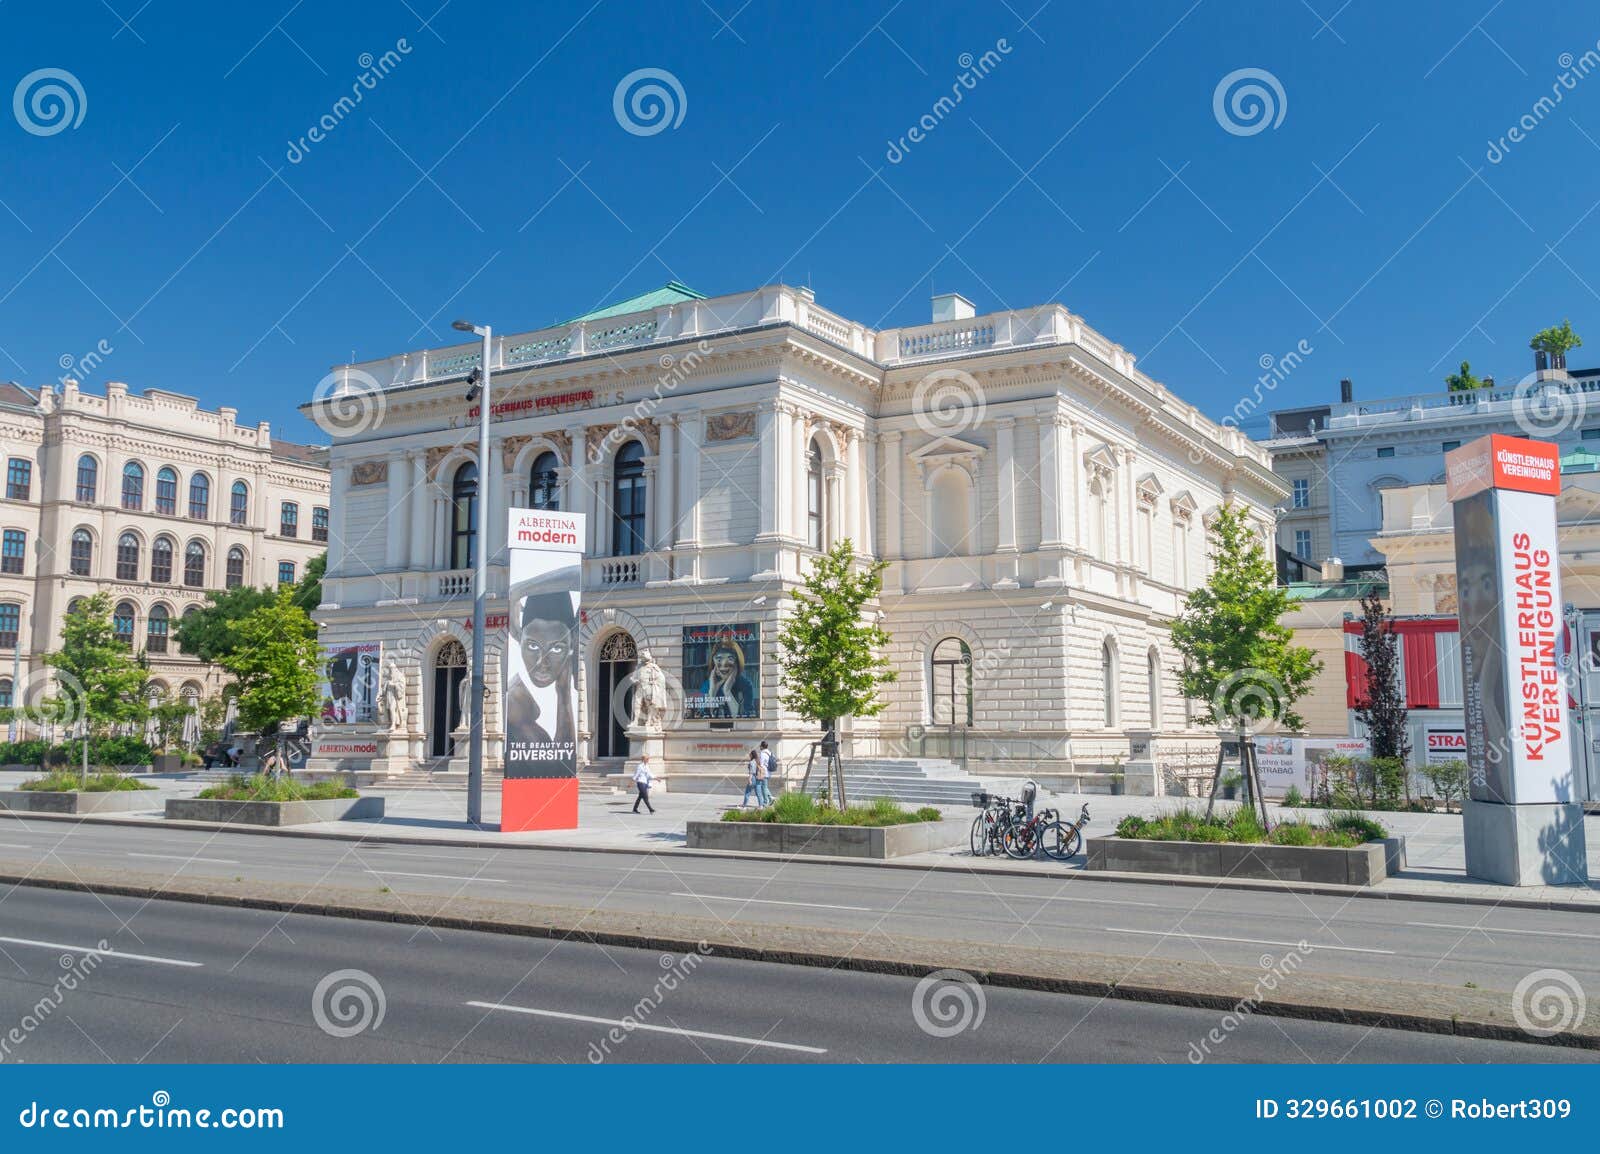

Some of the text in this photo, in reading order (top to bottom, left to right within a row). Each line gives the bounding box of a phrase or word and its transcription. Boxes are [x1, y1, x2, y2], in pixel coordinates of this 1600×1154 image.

[1497, 449, 1555, 470] KÜNSTLERHAUS
[1502, 464, 1551, 480] VEREINIGUNG
[519, 517, 576, 530] ALBERTINA
[518, 529, 576, 544] modern
[1513, 532, 1544, 761] KÜNSTLERHAUS
[1533, 549, 1561, 744] VEREINIGUNG
[354, 743, 377, 753] mode
[1428, 735, 1466, 747] STRA
[510, 750, 574, 760] DIVERSITY
